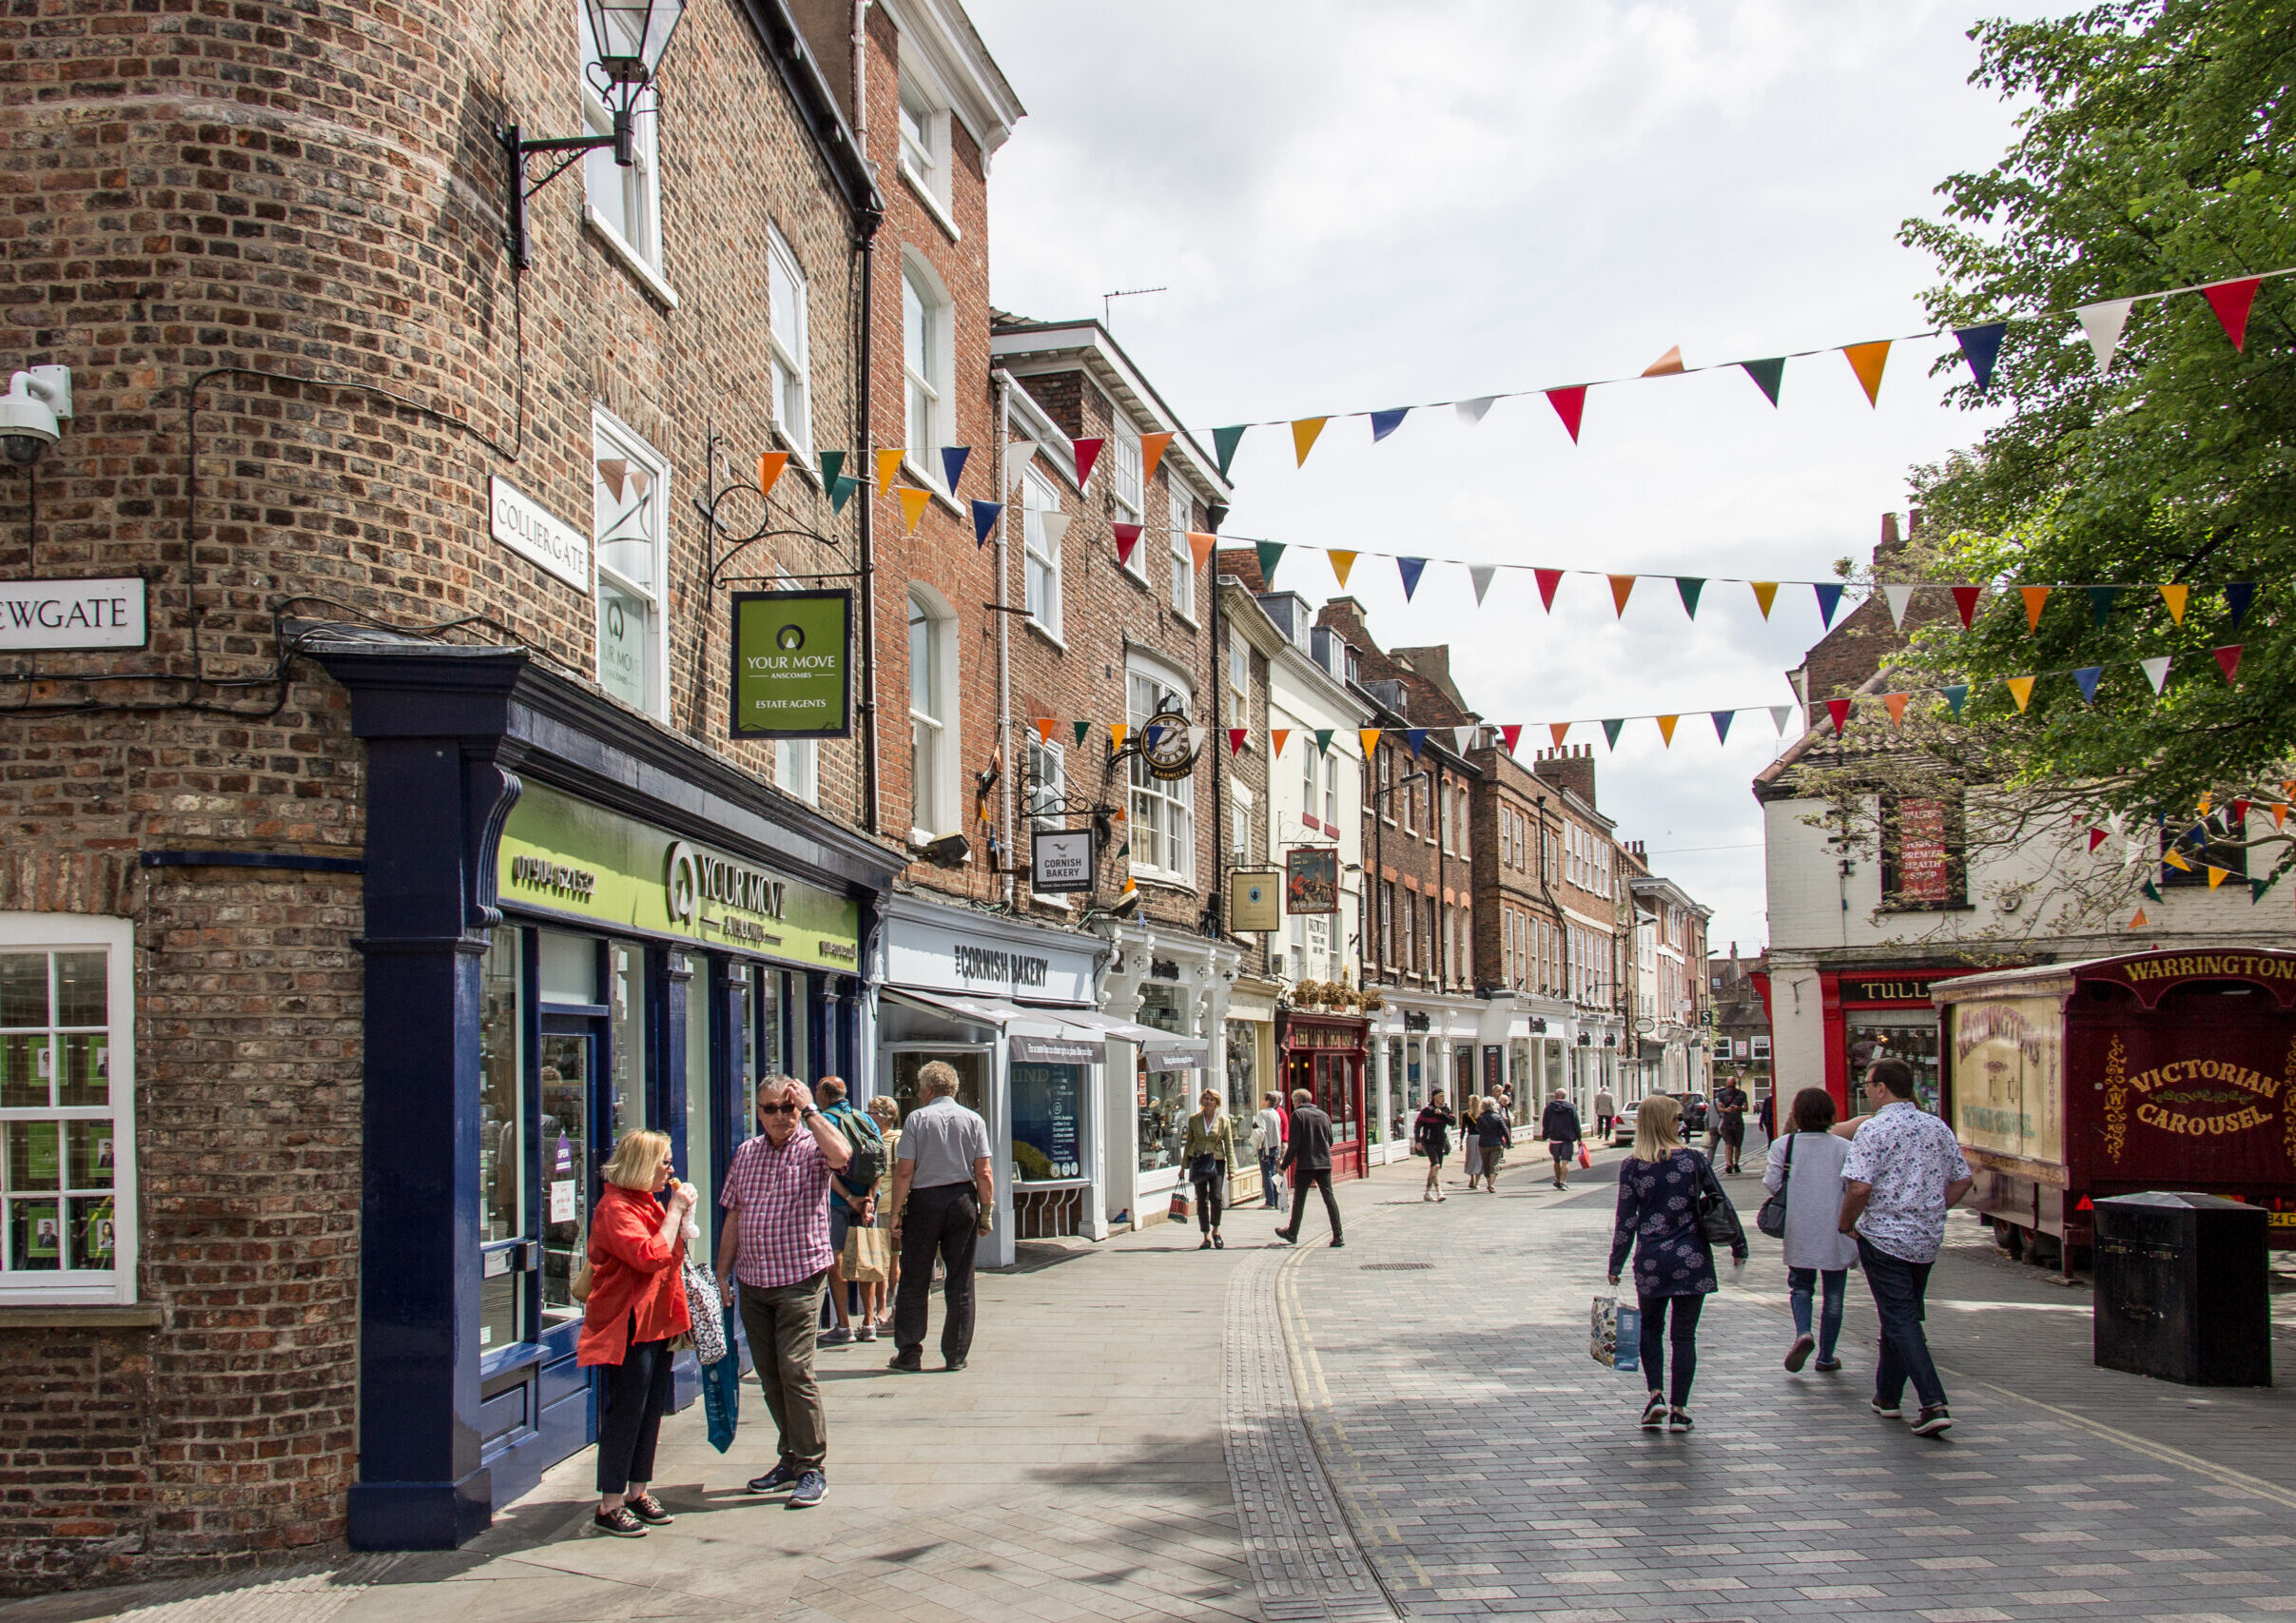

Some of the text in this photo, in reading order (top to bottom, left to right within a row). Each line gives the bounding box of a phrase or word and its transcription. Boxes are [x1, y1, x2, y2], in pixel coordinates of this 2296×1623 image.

[496, 498, 584, 576] COLLIERGATE
[747, 655, 836, 669] YOUR MOVE
[755, 698, 827, 709] ESTATE AGENTS
[1044, 858, 1081, 868] CORNISH
[1904, 860, 1941, 870] HEALTH
[515, 854, 555, 886] 01904
[1046, 868, 1080, 877] BAKERY
[700, 853, 787, 919] YOUR MOVE
[961, 946, 1009, 983] CORNISH
[1011, 953, 1048, 987] BAKERY
[2124, 955, 2296, 982] WARRINGTON
[1702, 1011, 1710, 1023] S
[2129, 1059, 2281, 1098] VICTORIAN
[2136, 1103, 2273, 1136] CAROUSEL
[556, 1147, 570, 1159] OPEN
[2105, 1244, 2127, 1255] LITTER
[2150, 1250, 2172, 1261] LITTER
